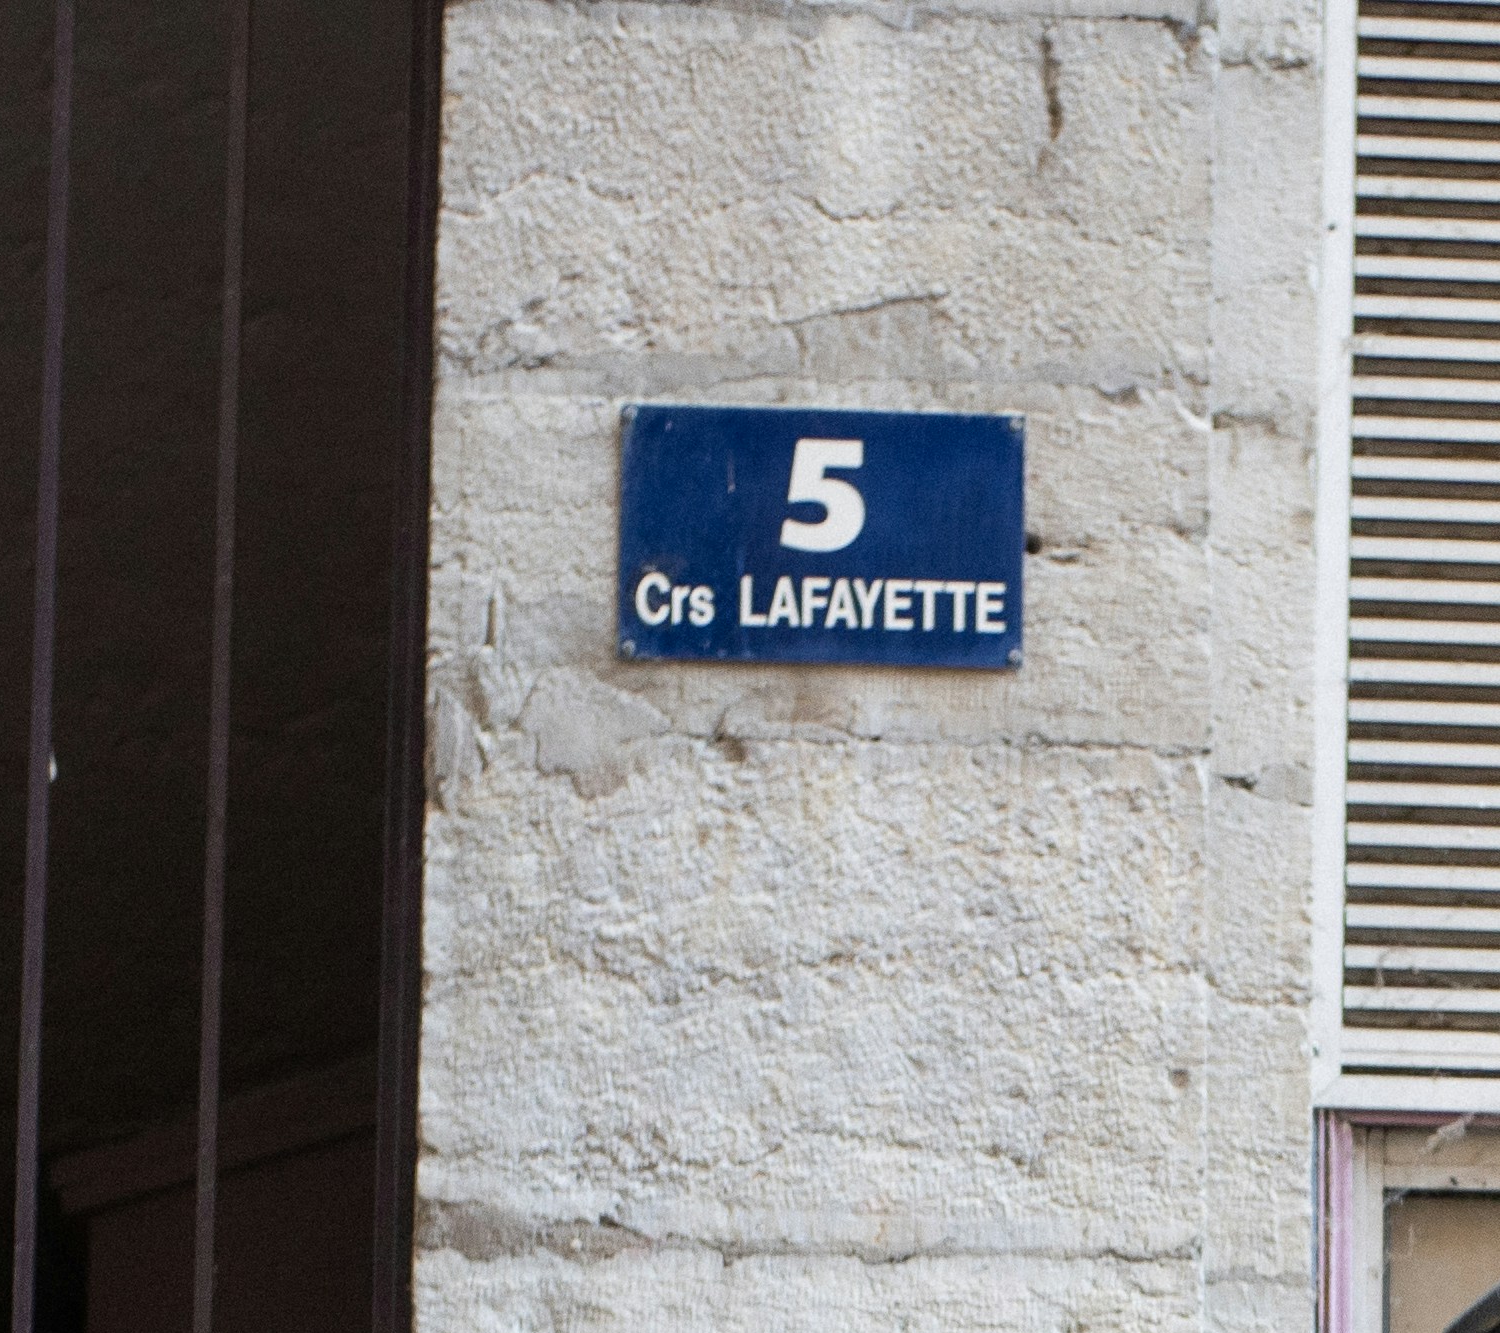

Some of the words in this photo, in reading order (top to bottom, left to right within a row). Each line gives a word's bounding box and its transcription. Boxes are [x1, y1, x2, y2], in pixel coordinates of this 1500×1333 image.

[780, 438, 867, 553] 5
[634, 571, 715, 628] Crs
[739, 574, 1007, 634] LAFAYETTE
